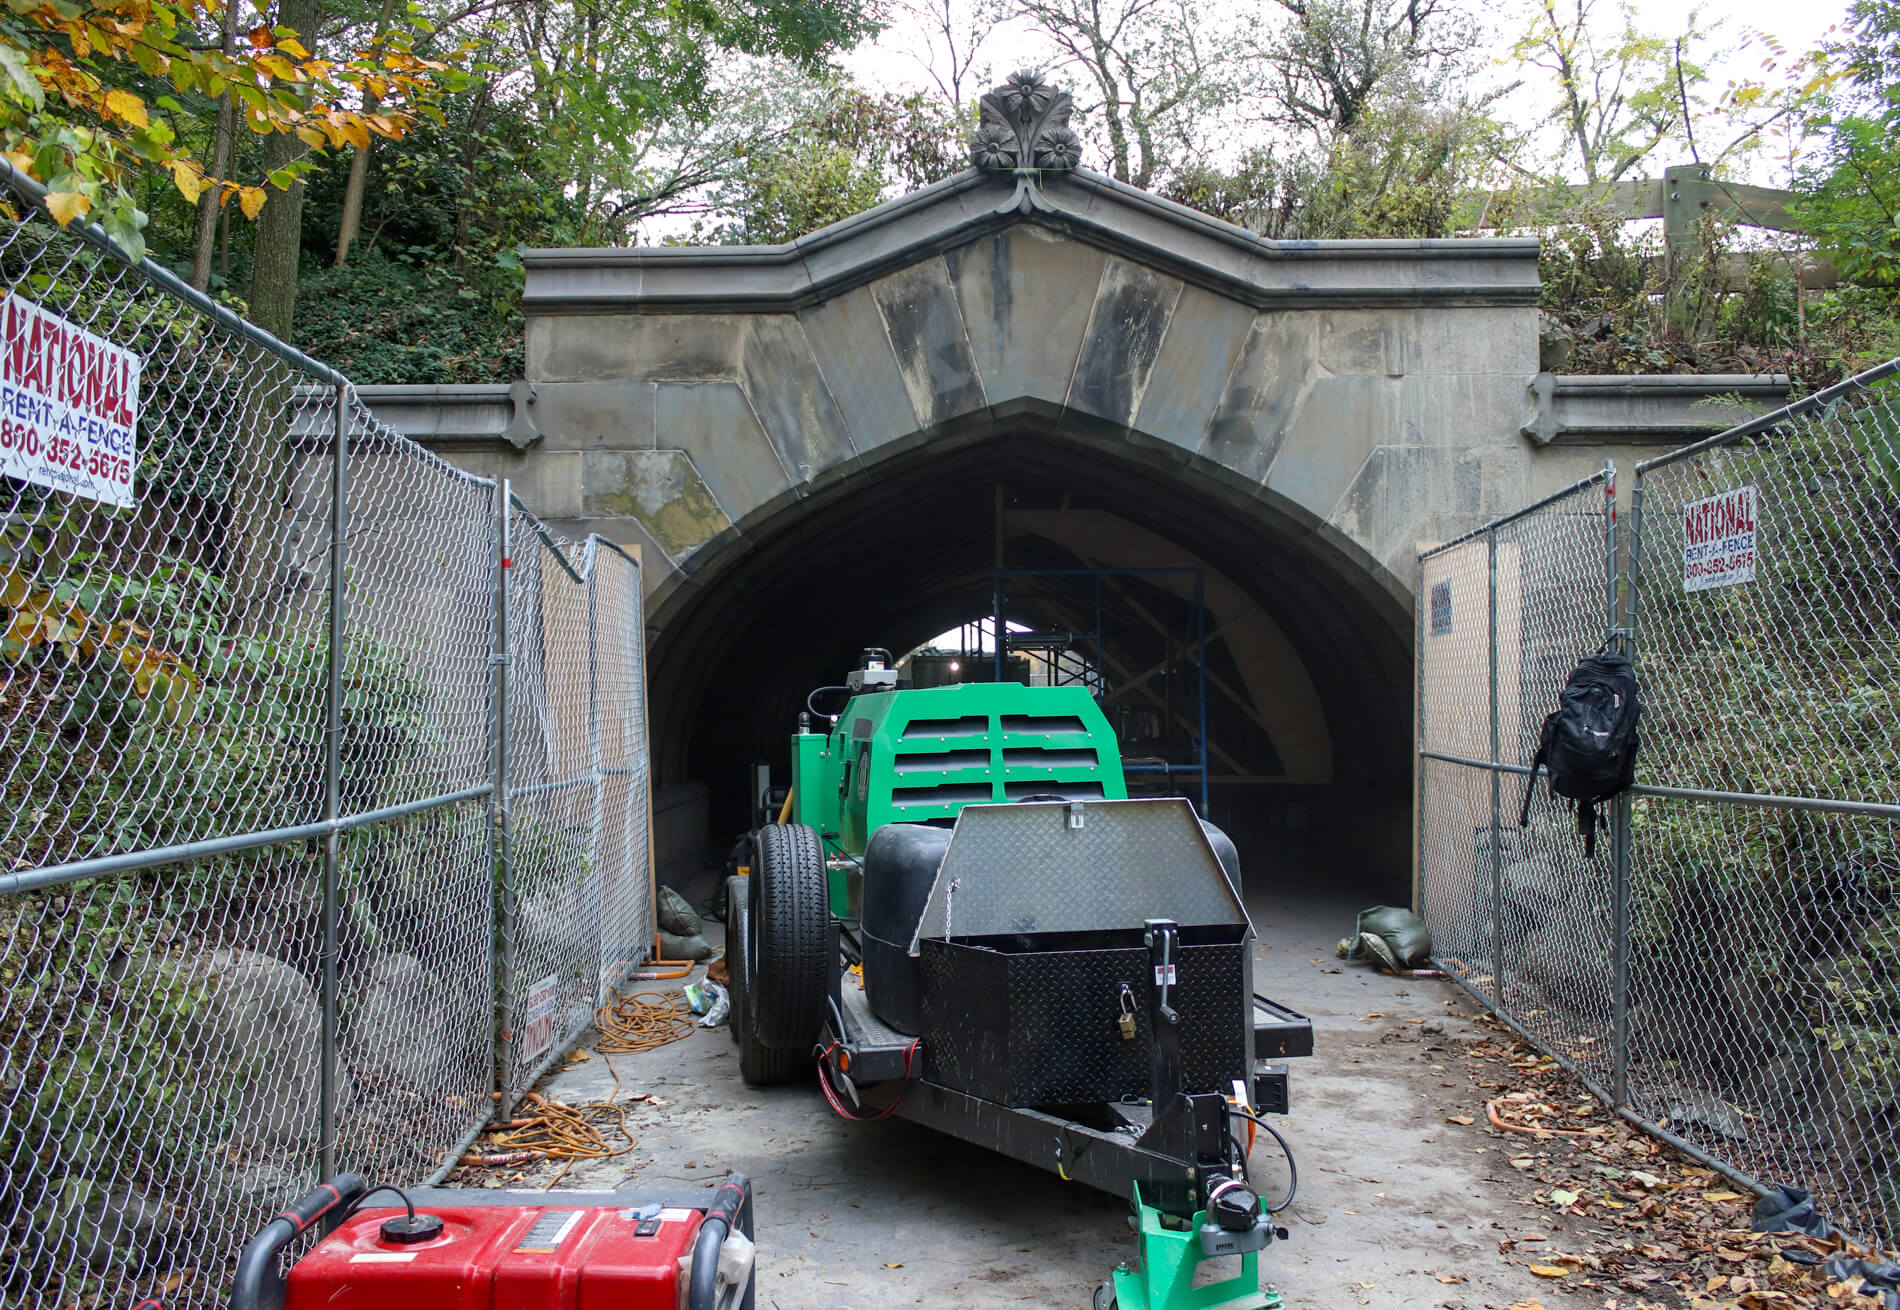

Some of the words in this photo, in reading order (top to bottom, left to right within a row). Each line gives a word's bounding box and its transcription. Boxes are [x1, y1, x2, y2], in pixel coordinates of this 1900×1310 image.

[4, 301, 133, 429] NATIONAL
[1, 418, 130, 485] 800-352-5675
[1686, 491, 1754, 546] NATIONAL
[1686, 535, 1754, 561] RENT-A-FENCE
